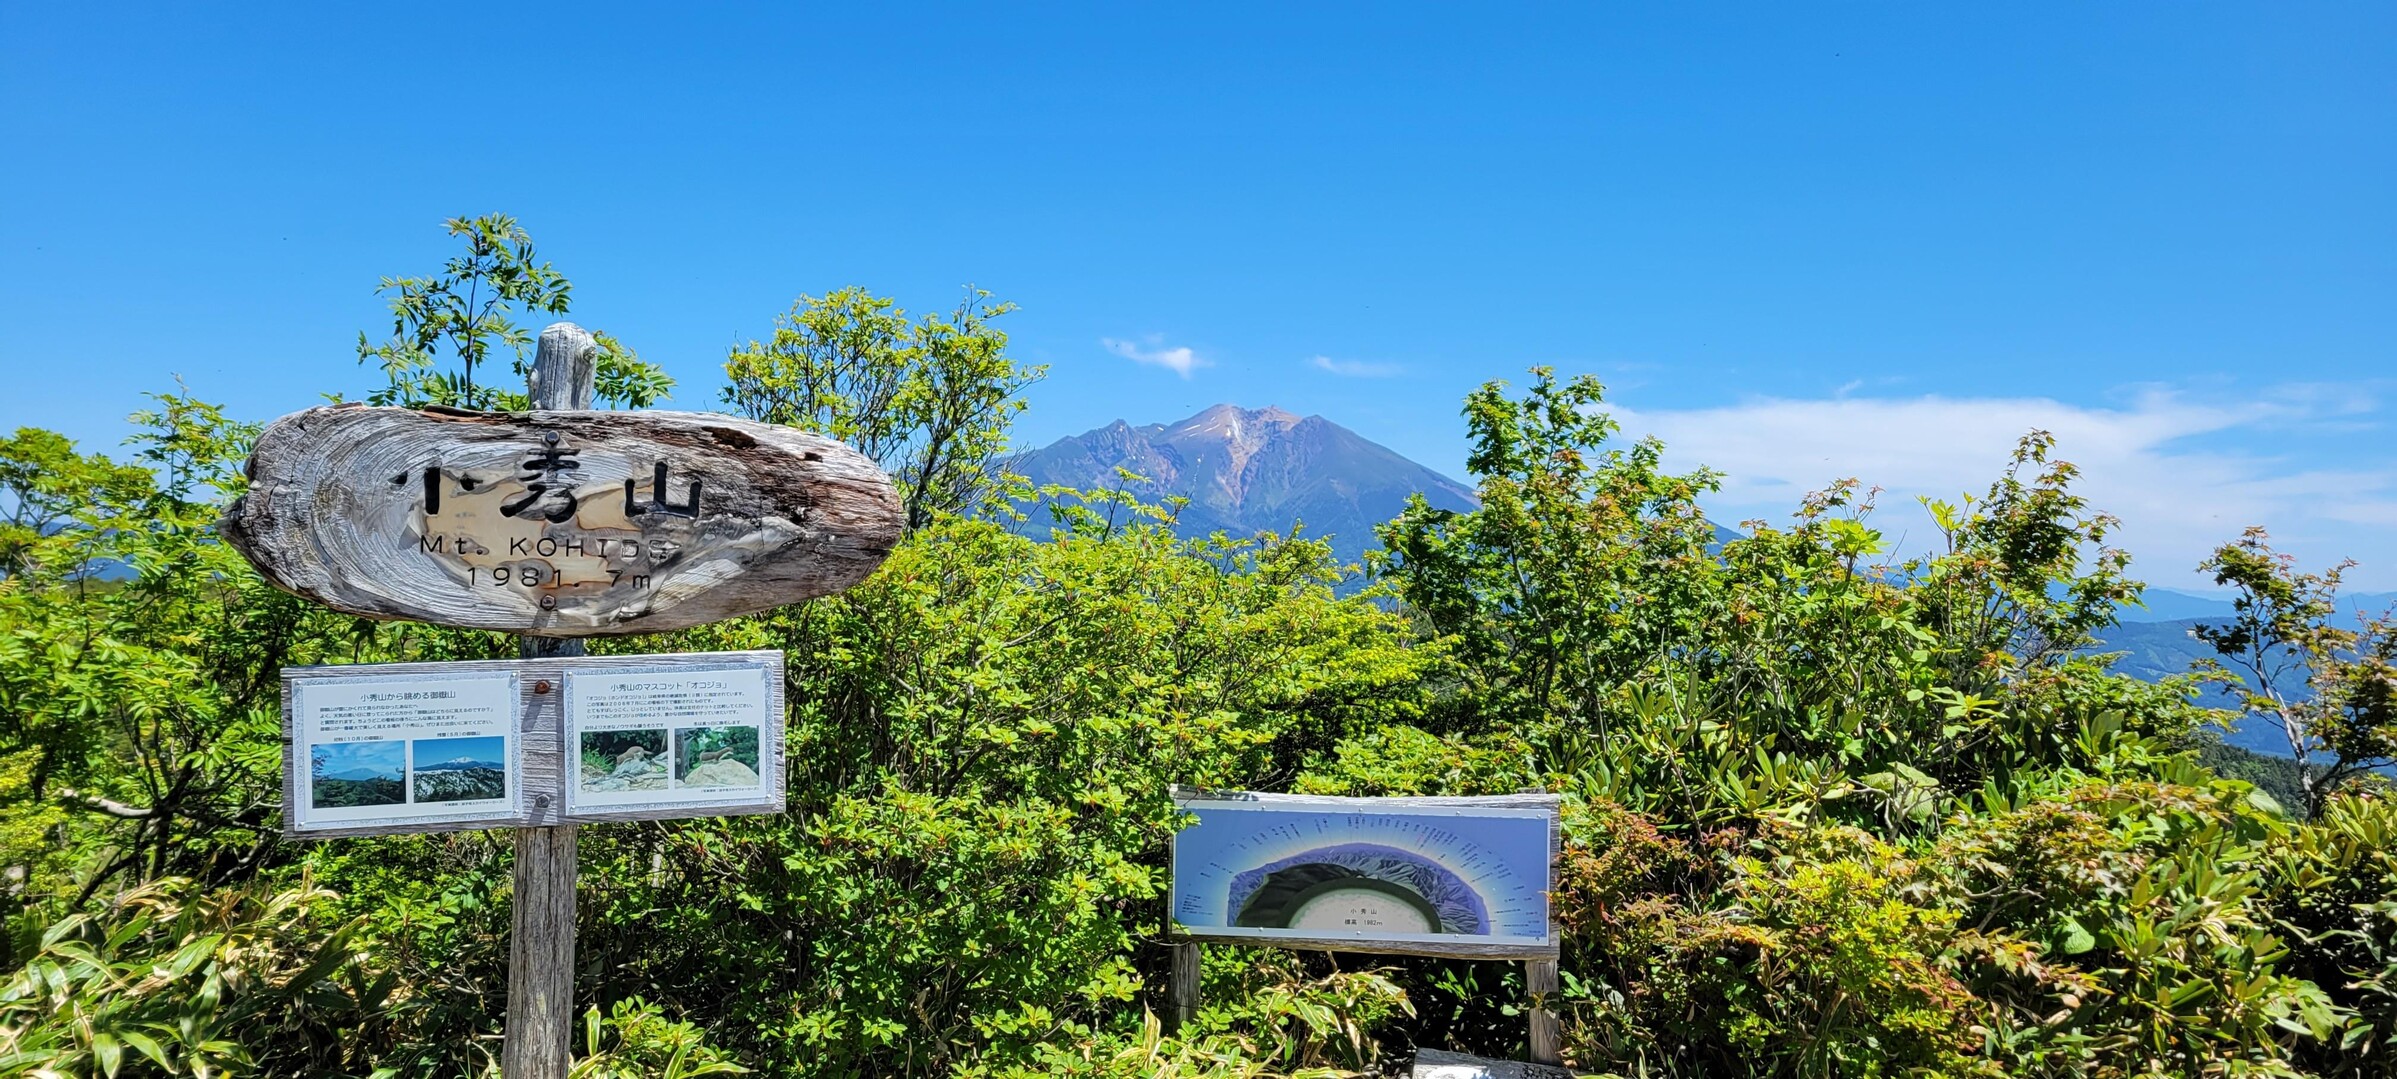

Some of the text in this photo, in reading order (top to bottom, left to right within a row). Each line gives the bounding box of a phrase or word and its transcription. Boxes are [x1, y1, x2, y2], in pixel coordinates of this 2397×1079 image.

[387, 448, 703, 524] 小秀山
[420, 535, 485, 556] Mt.
